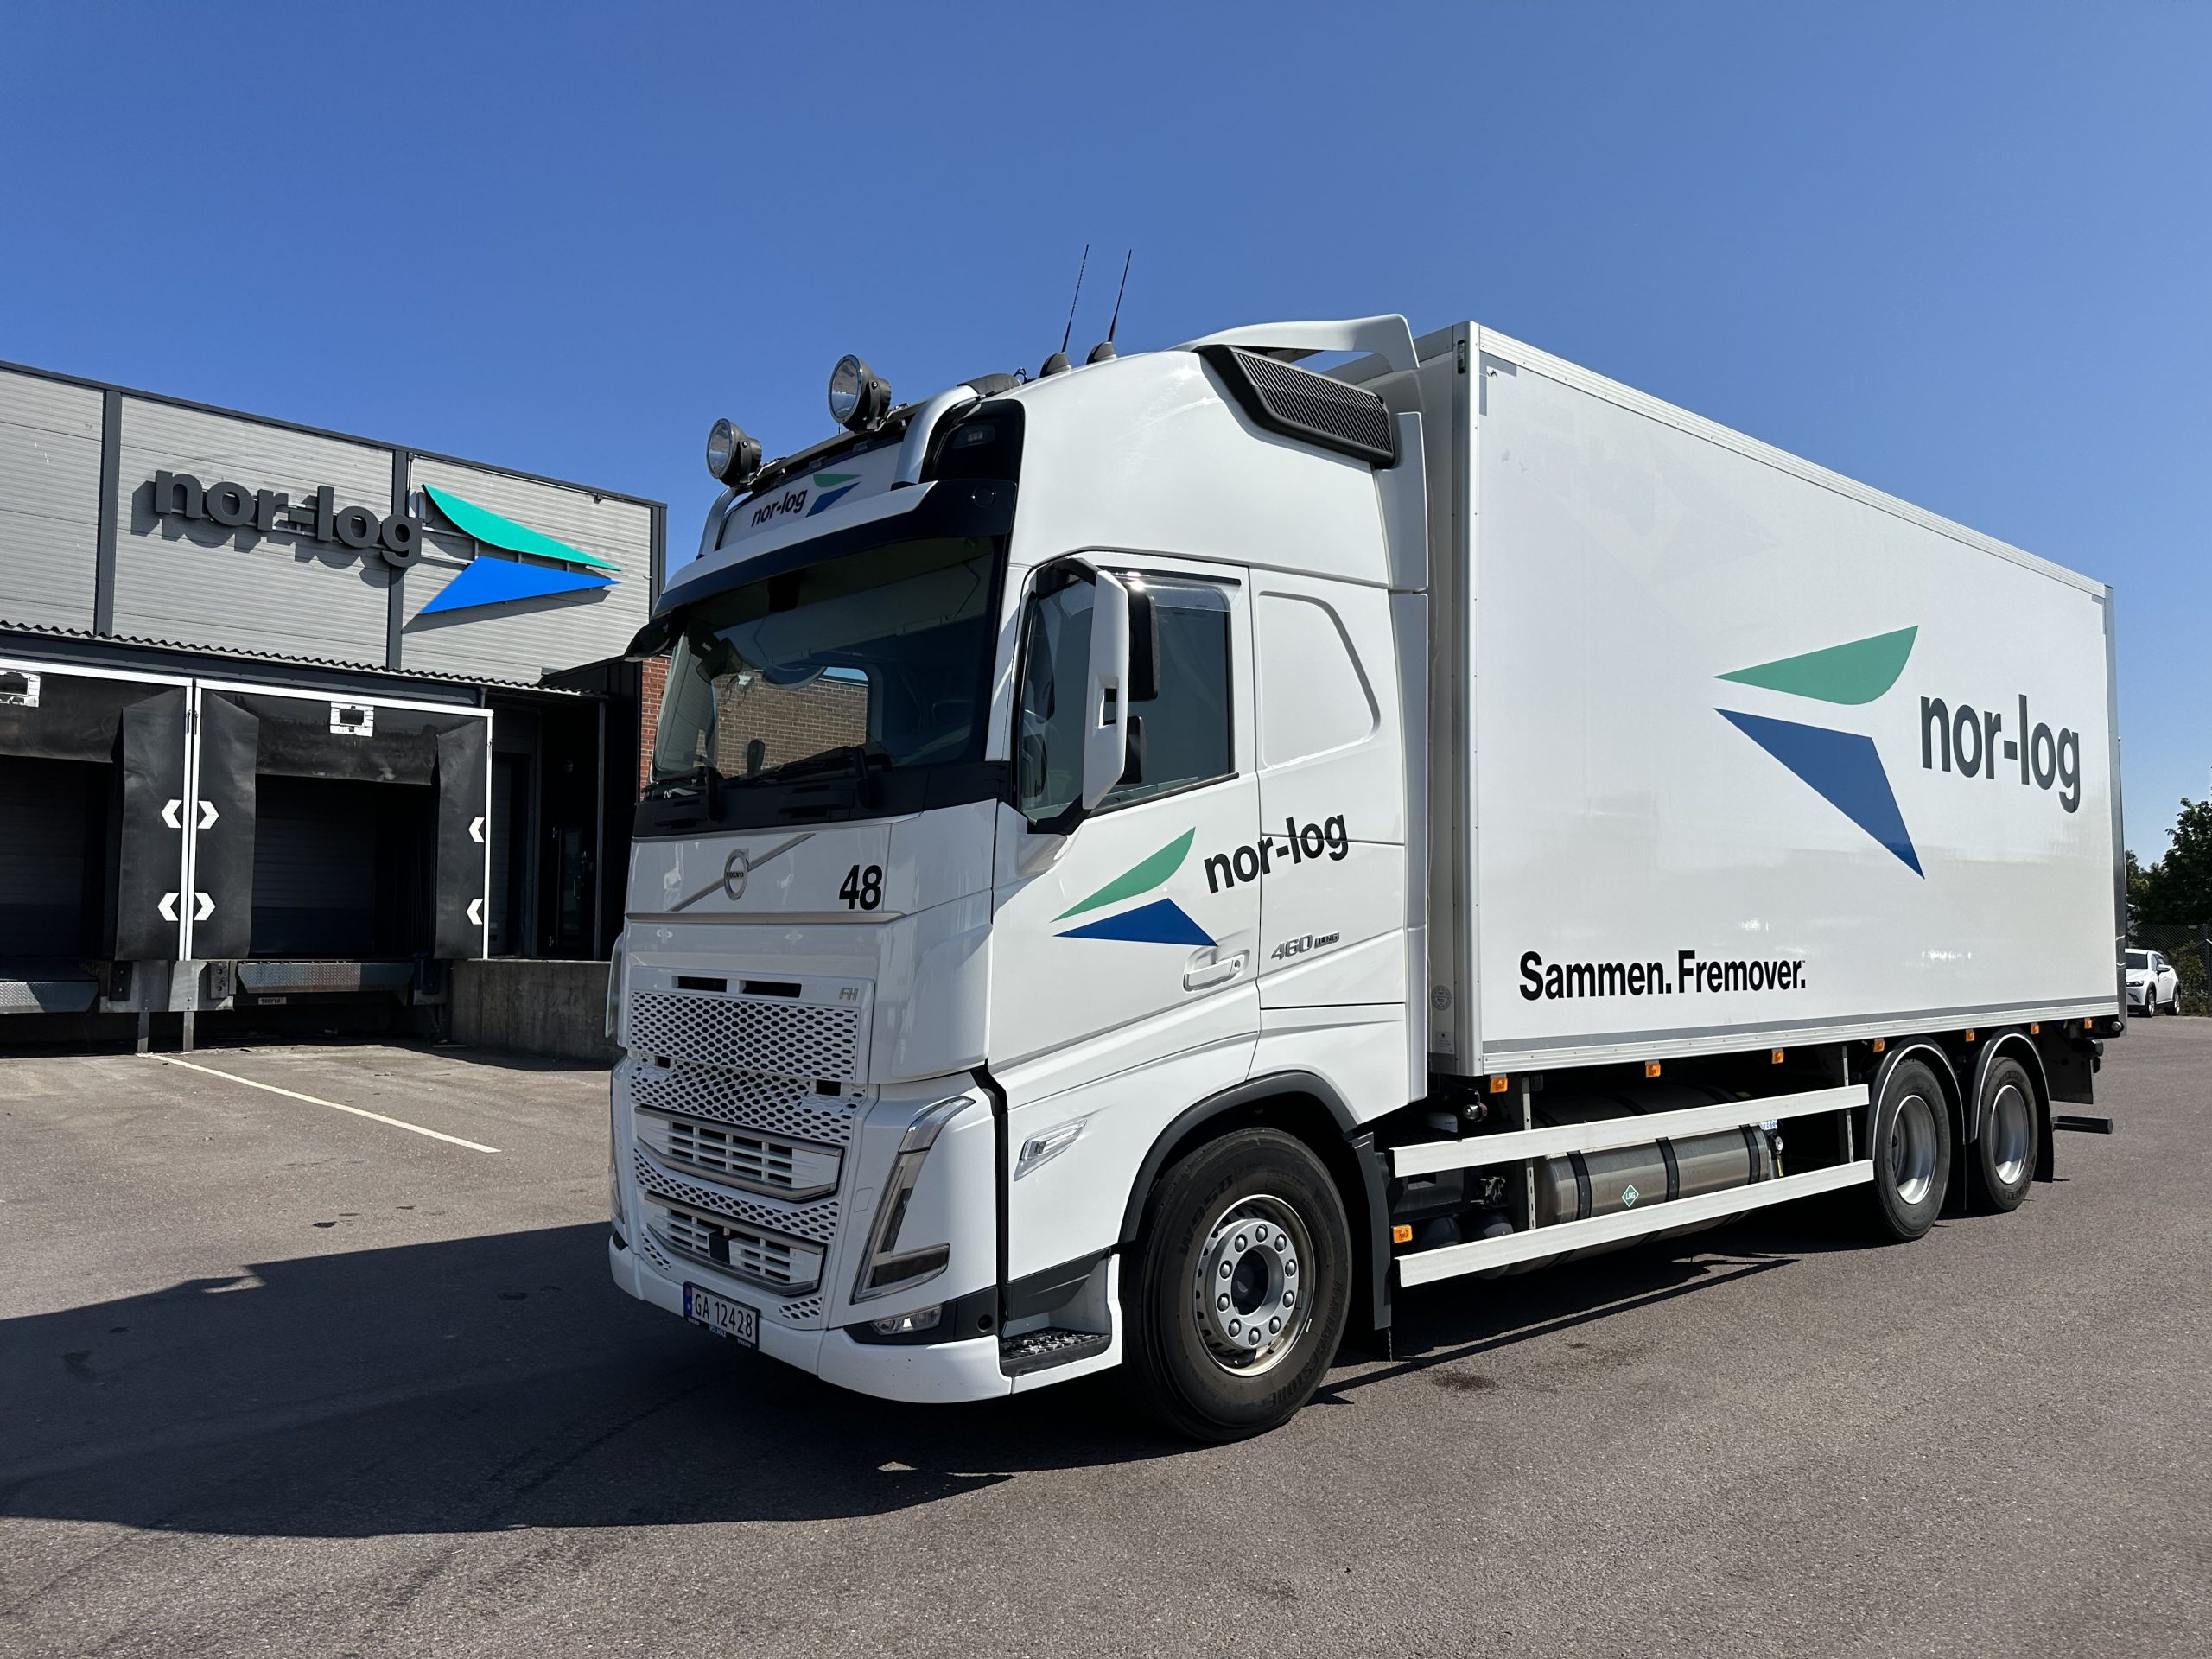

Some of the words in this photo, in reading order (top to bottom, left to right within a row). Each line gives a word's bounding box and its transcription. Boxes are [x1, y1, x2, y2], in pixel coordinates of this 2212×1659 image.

[155, 469, 423, 568] nor-log
[752, 489, 808, 527] nor-log
[1920, 694, 2081, 814] nor-log
[1204, 814, 1349, 894] nor-log
[839, 865, 882, 910] 48
[1271, 934, 1313, 960] 460
[839, 988, 858, 1000] FH
[1519, 950, 1672, 1001] Sammen.
[1678, 950, 1806, 994] Fremover.
[1625, 1192, 1636, 1200] LNG
[695, 1294, 709, 1319] GA
[715, 1302, 753, 1338] 12428
